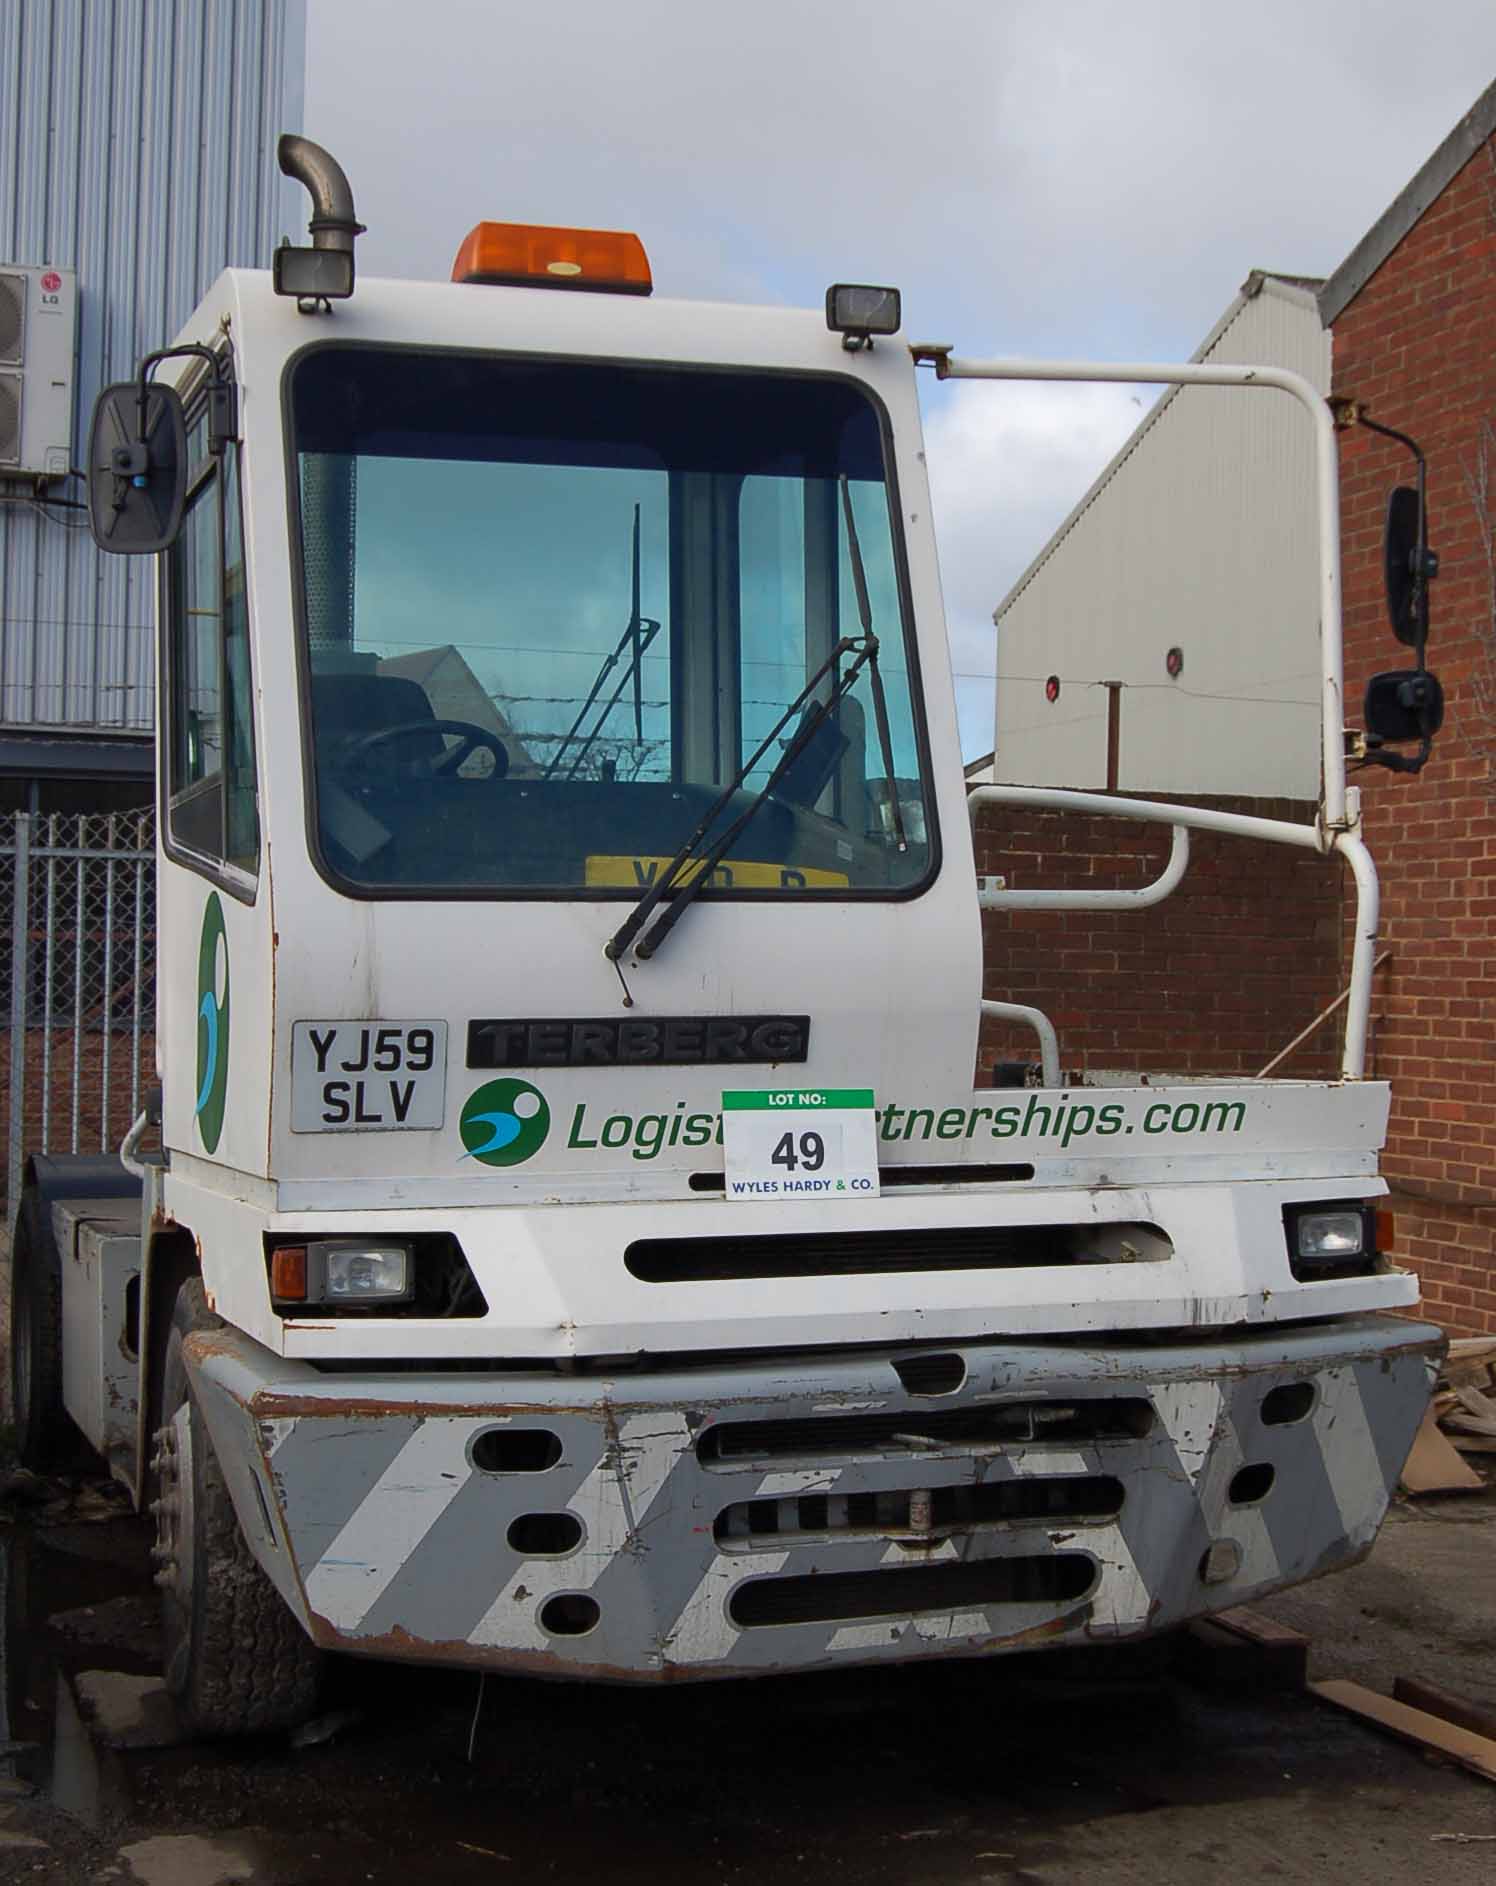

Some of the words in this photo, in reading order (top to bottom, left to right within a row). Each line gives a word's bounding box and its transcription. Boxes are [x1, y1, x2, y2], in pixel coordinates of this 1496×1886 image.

[42, 294, 59, 305] LG
[309, 1028, 434, 1073] YJ59
[477, 1021, 800, 1064] TERBERG
[322, 1080, 416, 1123] SLV
[768, 1093, 794, 1106] LOT
[798, 1093, 827, 1105] NO:
[771, 1131, 825, 1171] 49
[732, 1180, 779, 1193] WYLES
[783, 1179, 831, 1192] HARDY
[835, 1179, 846, 1191] &
[851, 1178, 875, 1190] CO.
